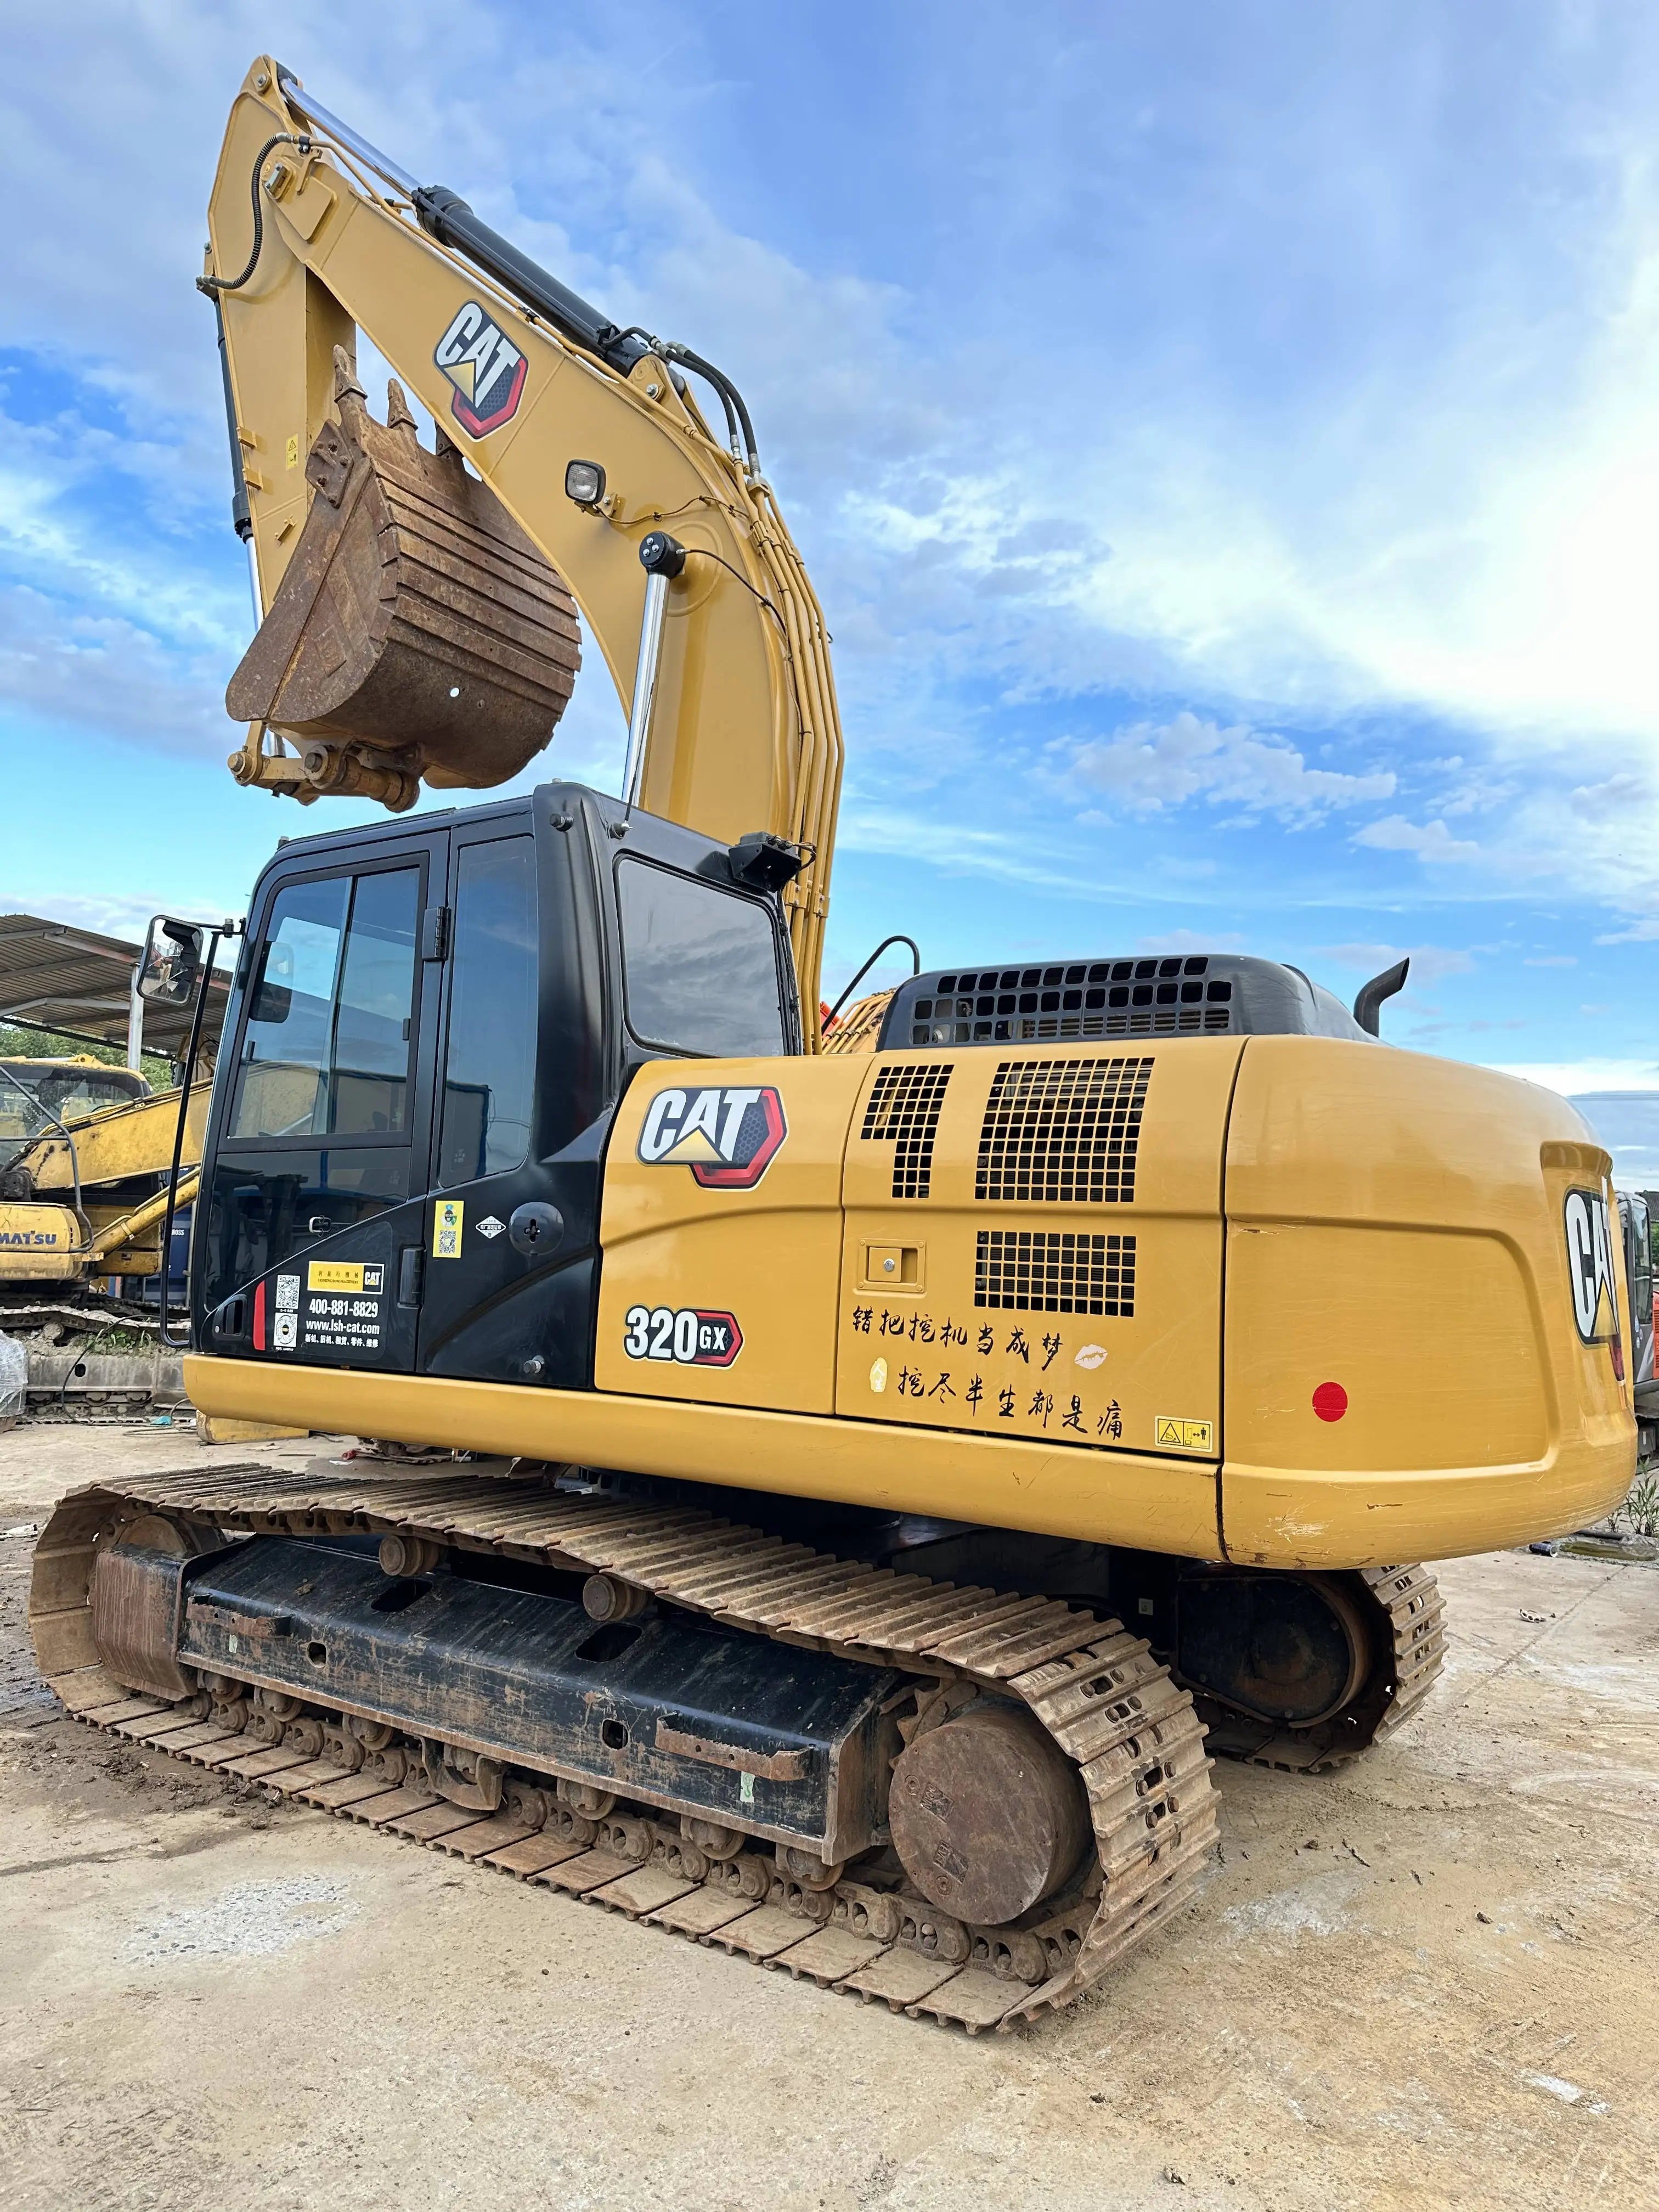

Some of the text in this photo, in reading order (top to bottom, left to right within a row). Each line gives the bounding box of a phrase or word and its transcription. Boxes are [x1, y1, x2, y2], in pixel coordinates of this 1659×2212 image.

[436, 303, 521, 408] CAT
[640, 1089, 761, 1162] CAT
[309, 1298, 379, 1318] 400-881-8829
[364, 1271, 381, 1286] CAT
[306, 1319, 380, 1335] www.lsh-cat.com
[853, 1305, 1063, 1371] 错把挖机当成梦
[898, 1365, 1122, 1440] 挖尽半生都是痛
